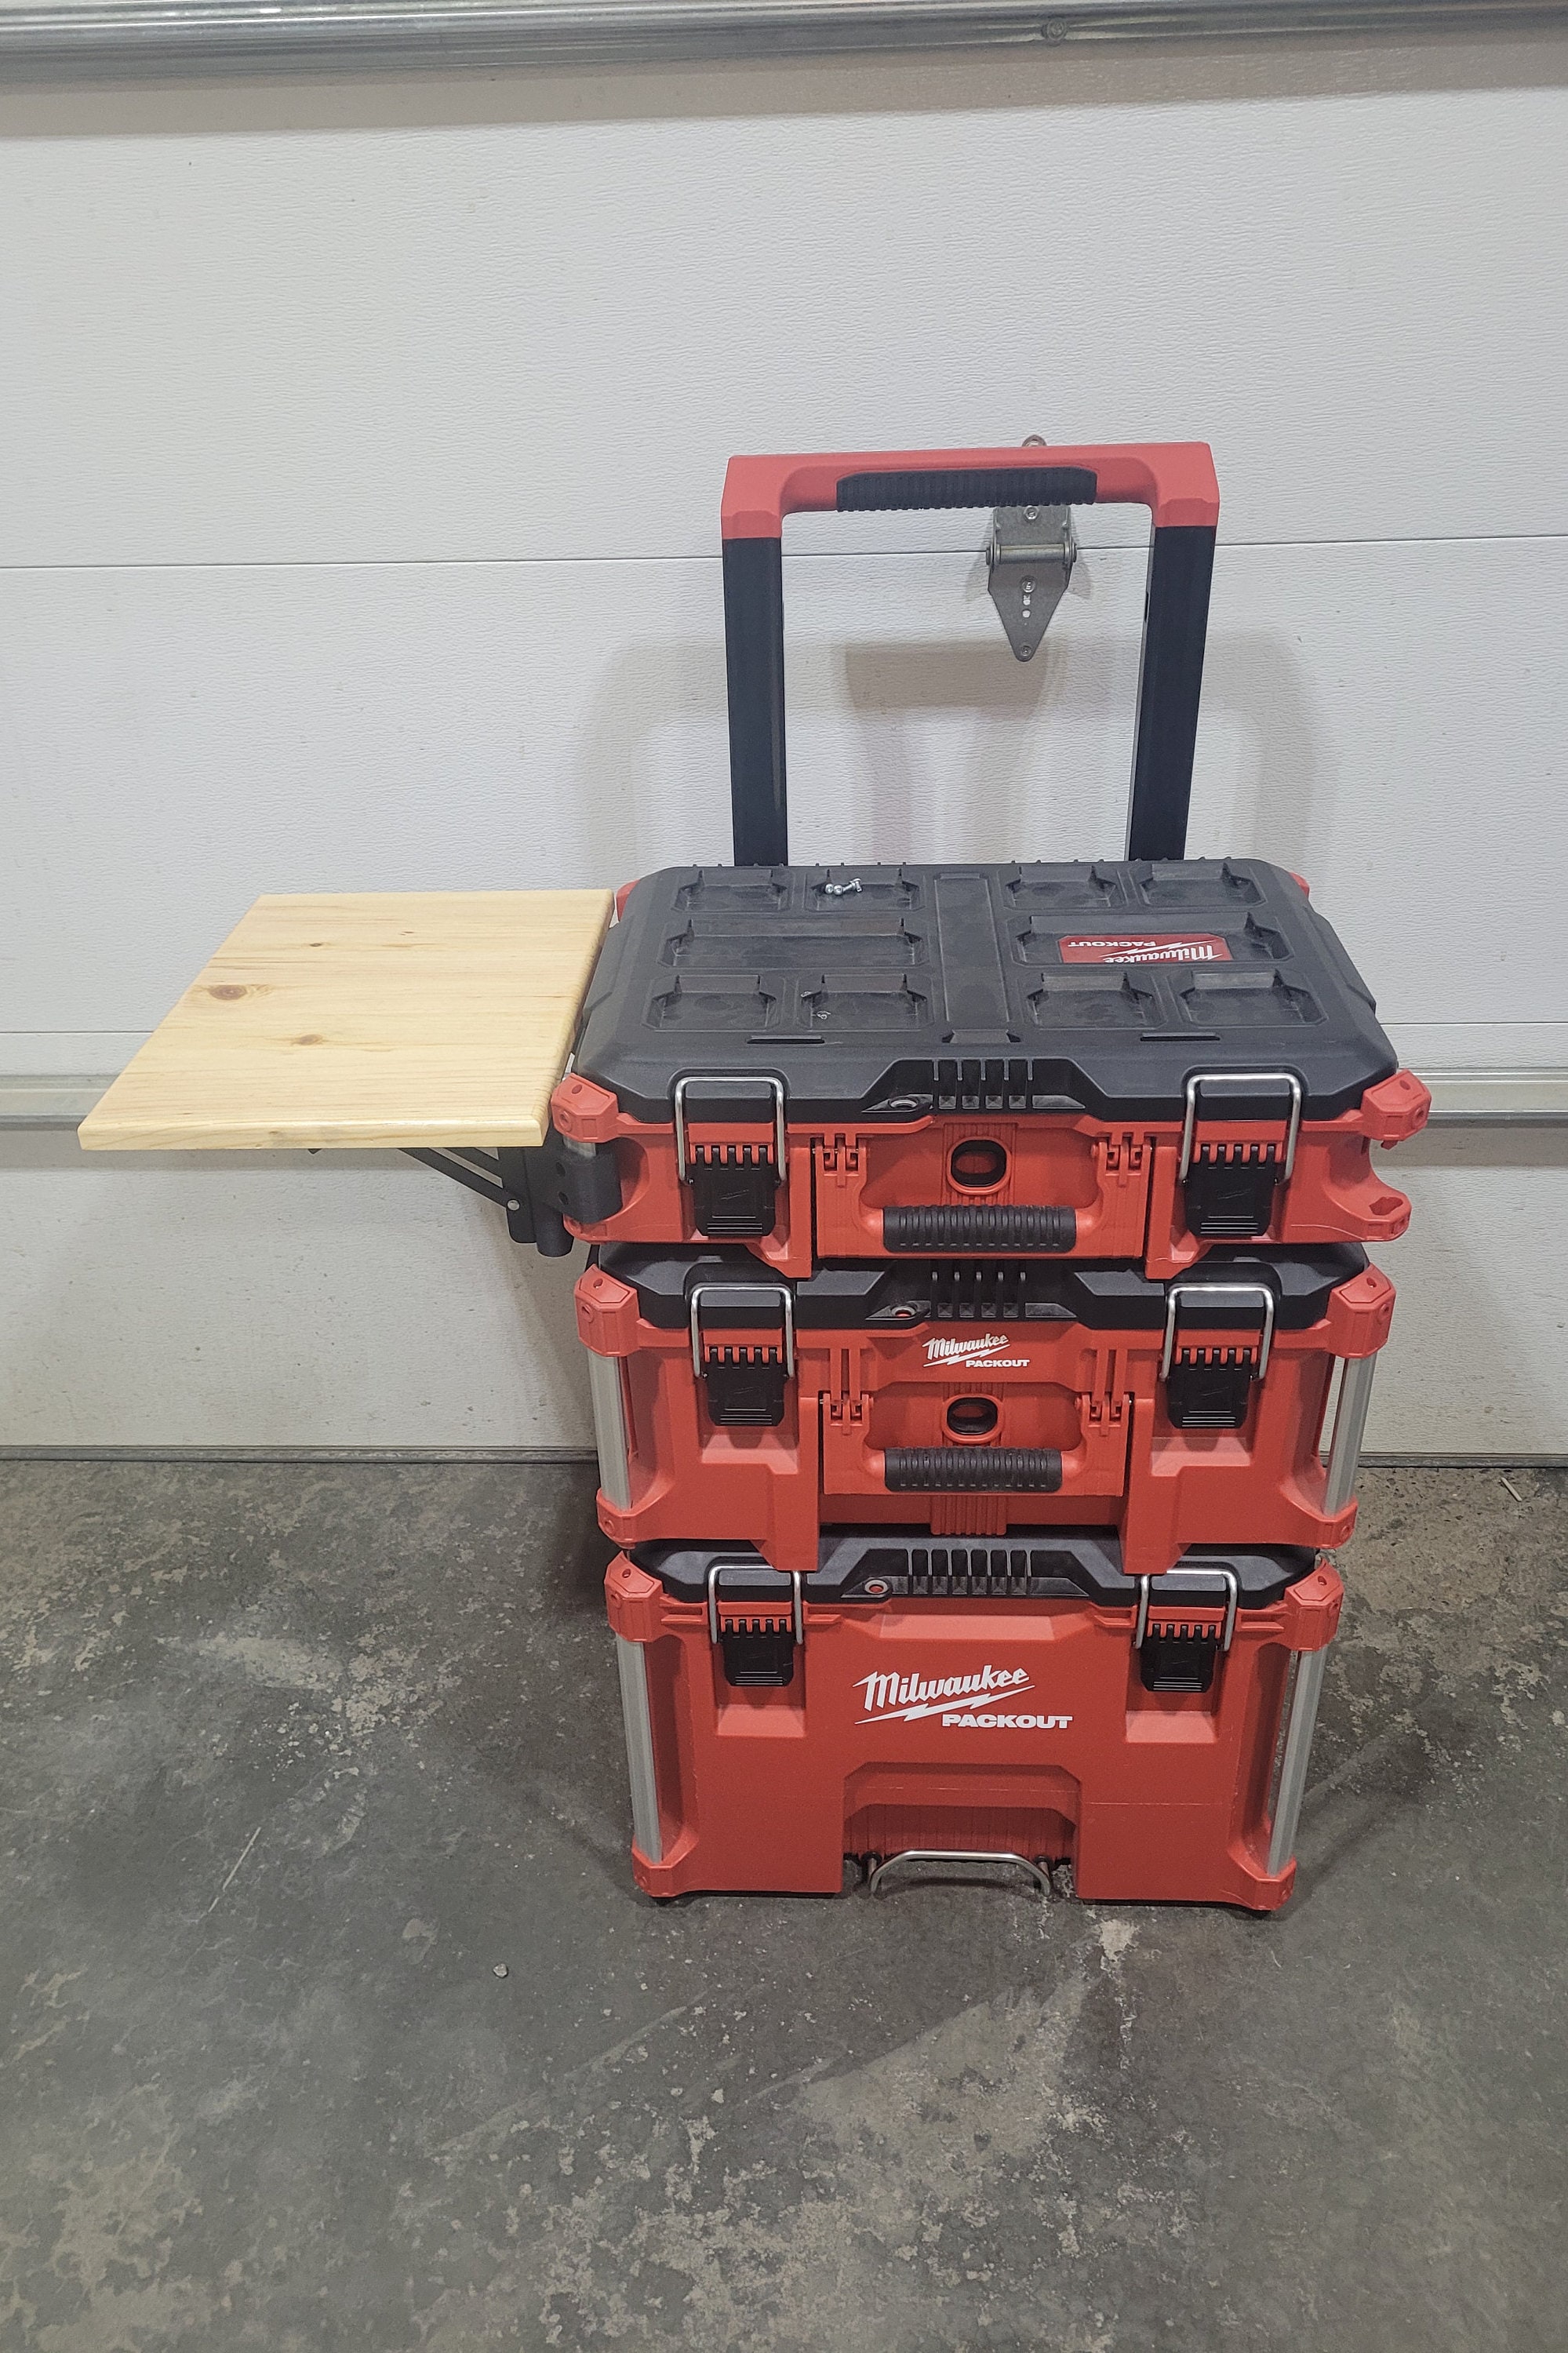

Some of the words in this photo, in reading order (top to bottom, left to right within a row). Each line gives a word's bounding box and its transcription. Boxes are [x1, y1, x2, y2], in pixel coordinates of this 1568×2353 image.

[1103, 944, 1223, 963] Milwaukee
[922, 1333, 1010, 1360] Milwaukee
[852, 1664, 1030, 1711] Milwaukee
[942, 1714, 1073, 1729] PACKOUT
